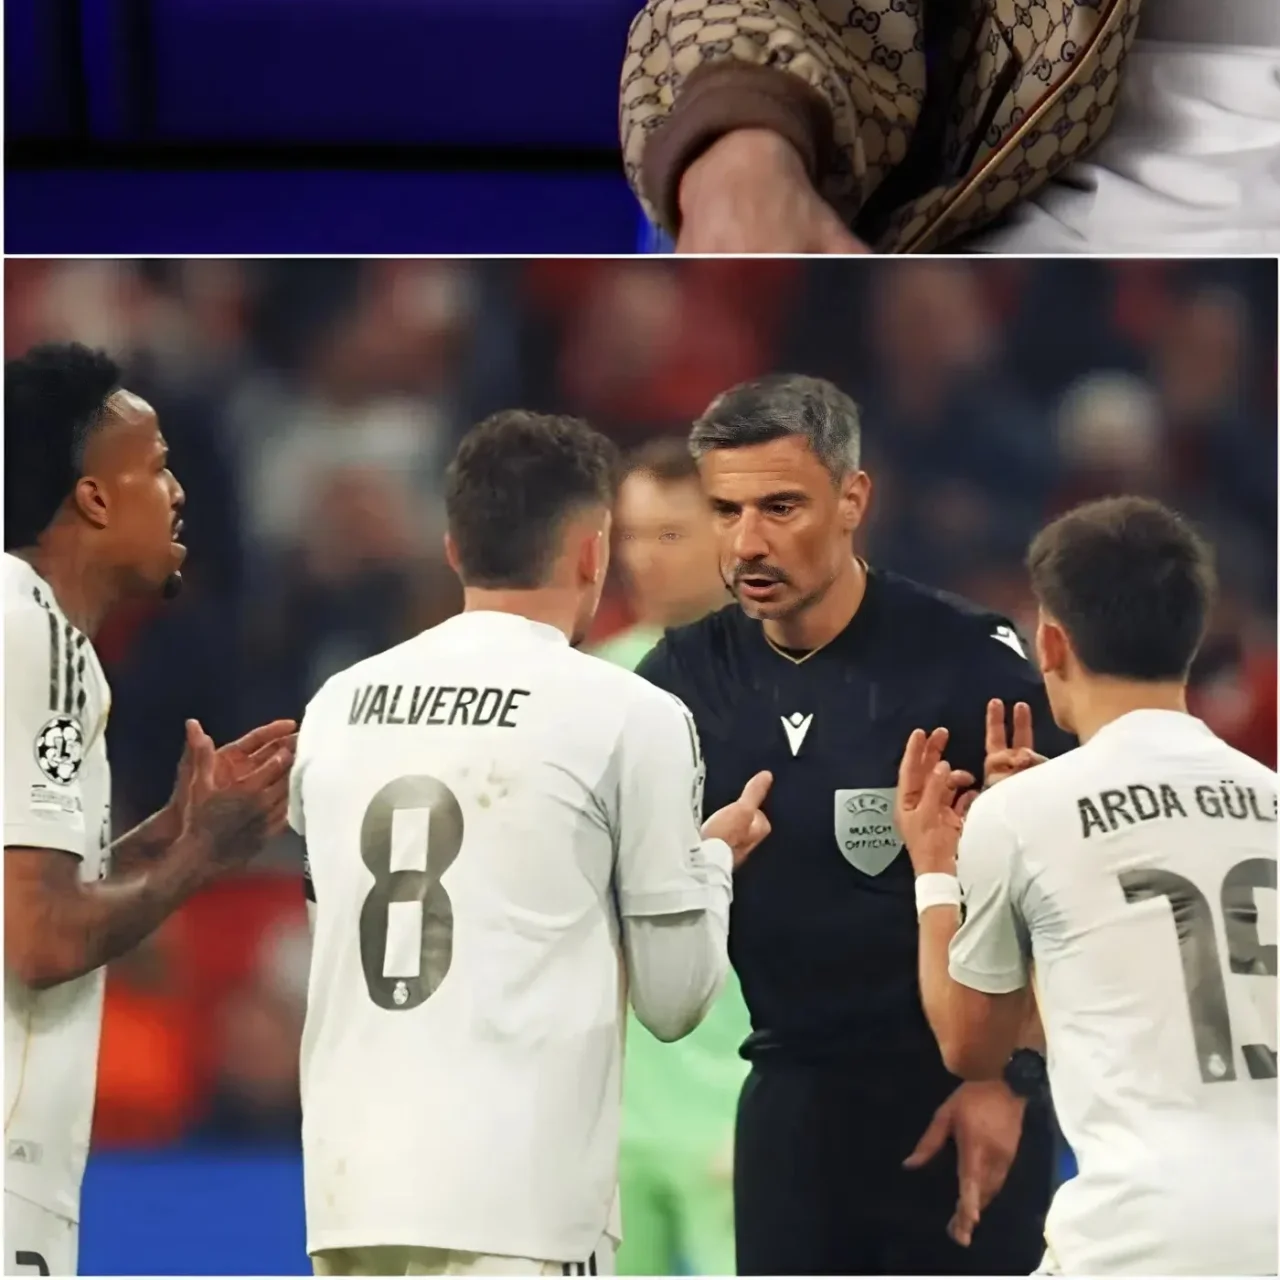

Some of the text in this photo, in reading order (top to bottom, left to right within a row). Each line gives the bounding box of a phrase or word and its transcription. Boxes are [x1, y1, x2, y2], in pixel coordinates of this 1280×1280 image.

[348, 684, 531, 728] VALVERDE
[1077, 780, 1278, 839] ARDA GÜL
[359, 774, 464, 1011] 8
